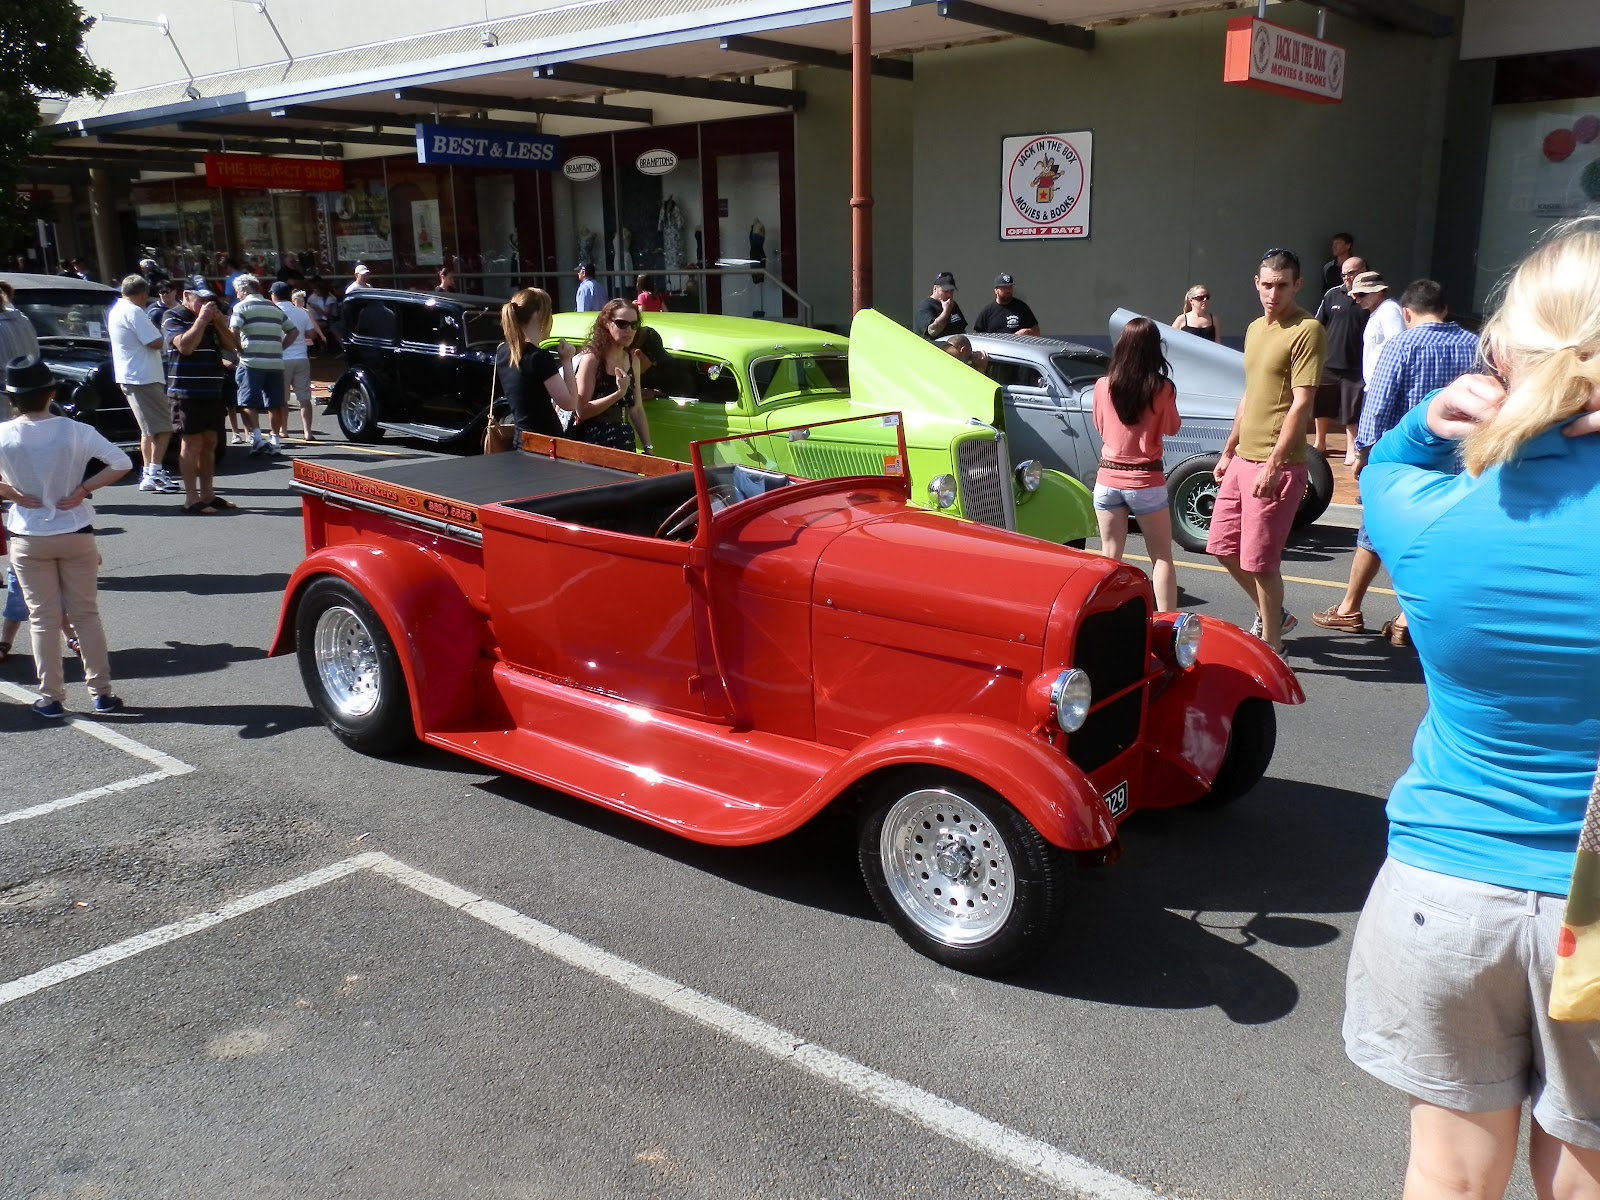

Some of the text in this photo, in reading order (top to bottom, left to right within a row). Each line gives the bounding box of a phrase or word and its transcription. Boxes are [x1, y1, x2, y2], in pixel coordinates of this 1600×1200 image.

[1274, 34, 1291, 62] JACK
[1292, 39, 1300, 65] IN
[1301, 42, 1313, 68] THE
[1313, 46, 1326, 72] BOX
[1271, 63, 1326, 88] MOVIES & BOOKS
[432, 135, 554, 161] BEST & LESS
[1018, 140, 1077, 167] JACK IN THE BOX
[216, 161, 245, 176] THE
[304, 166, 340, 180] SHOP
[565, 162, 597, 174] BRAMPTONS
[640, 156, 673, 168] BRAMPTONS
[1015, 195, 1075, 221] MOVIES & BOOKS
[1051, 226, 1081, 234] DAYS
[300, 466, 347, 488] Capalaba
[349, 478, 398, 502] Wreckers
